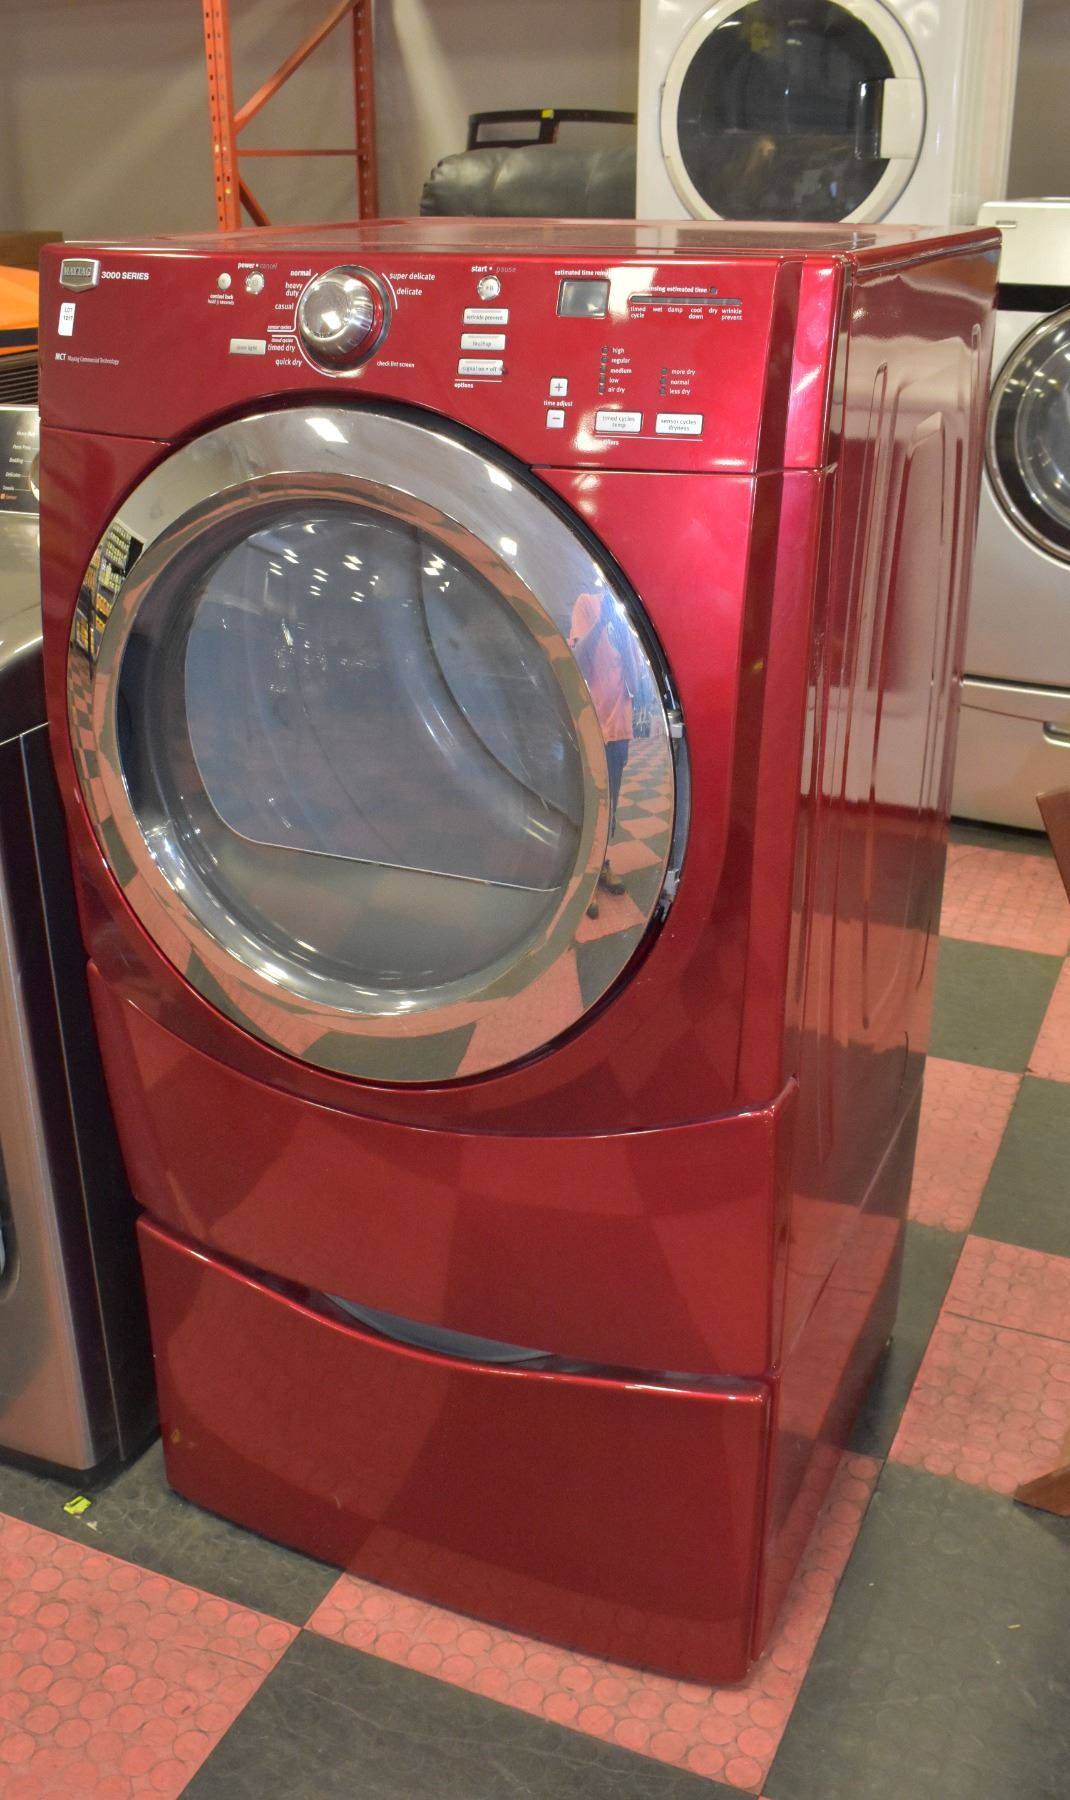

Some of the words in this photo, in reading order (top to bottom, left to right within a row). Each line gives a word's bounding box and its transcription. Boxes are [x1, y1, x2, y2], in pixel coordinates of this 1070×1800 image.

[237, 262, 255, 270] power
[63, 266, 92, 276] MAYTAG
[101, 272, 120, 280] 3000
[122, 272, 150, 280] SERIES
[389, 272, 408, 280] super
[408, 272, 436, 280] delicate
[285, 282, 303, 290] heavy
[286, 290, 299, 298] duty
[396, 287, 422, 296] delicate
[285, 344, 295, 353] dry
[275, 358, 291, 367] quick
[292, 359, 303, 367] dry
